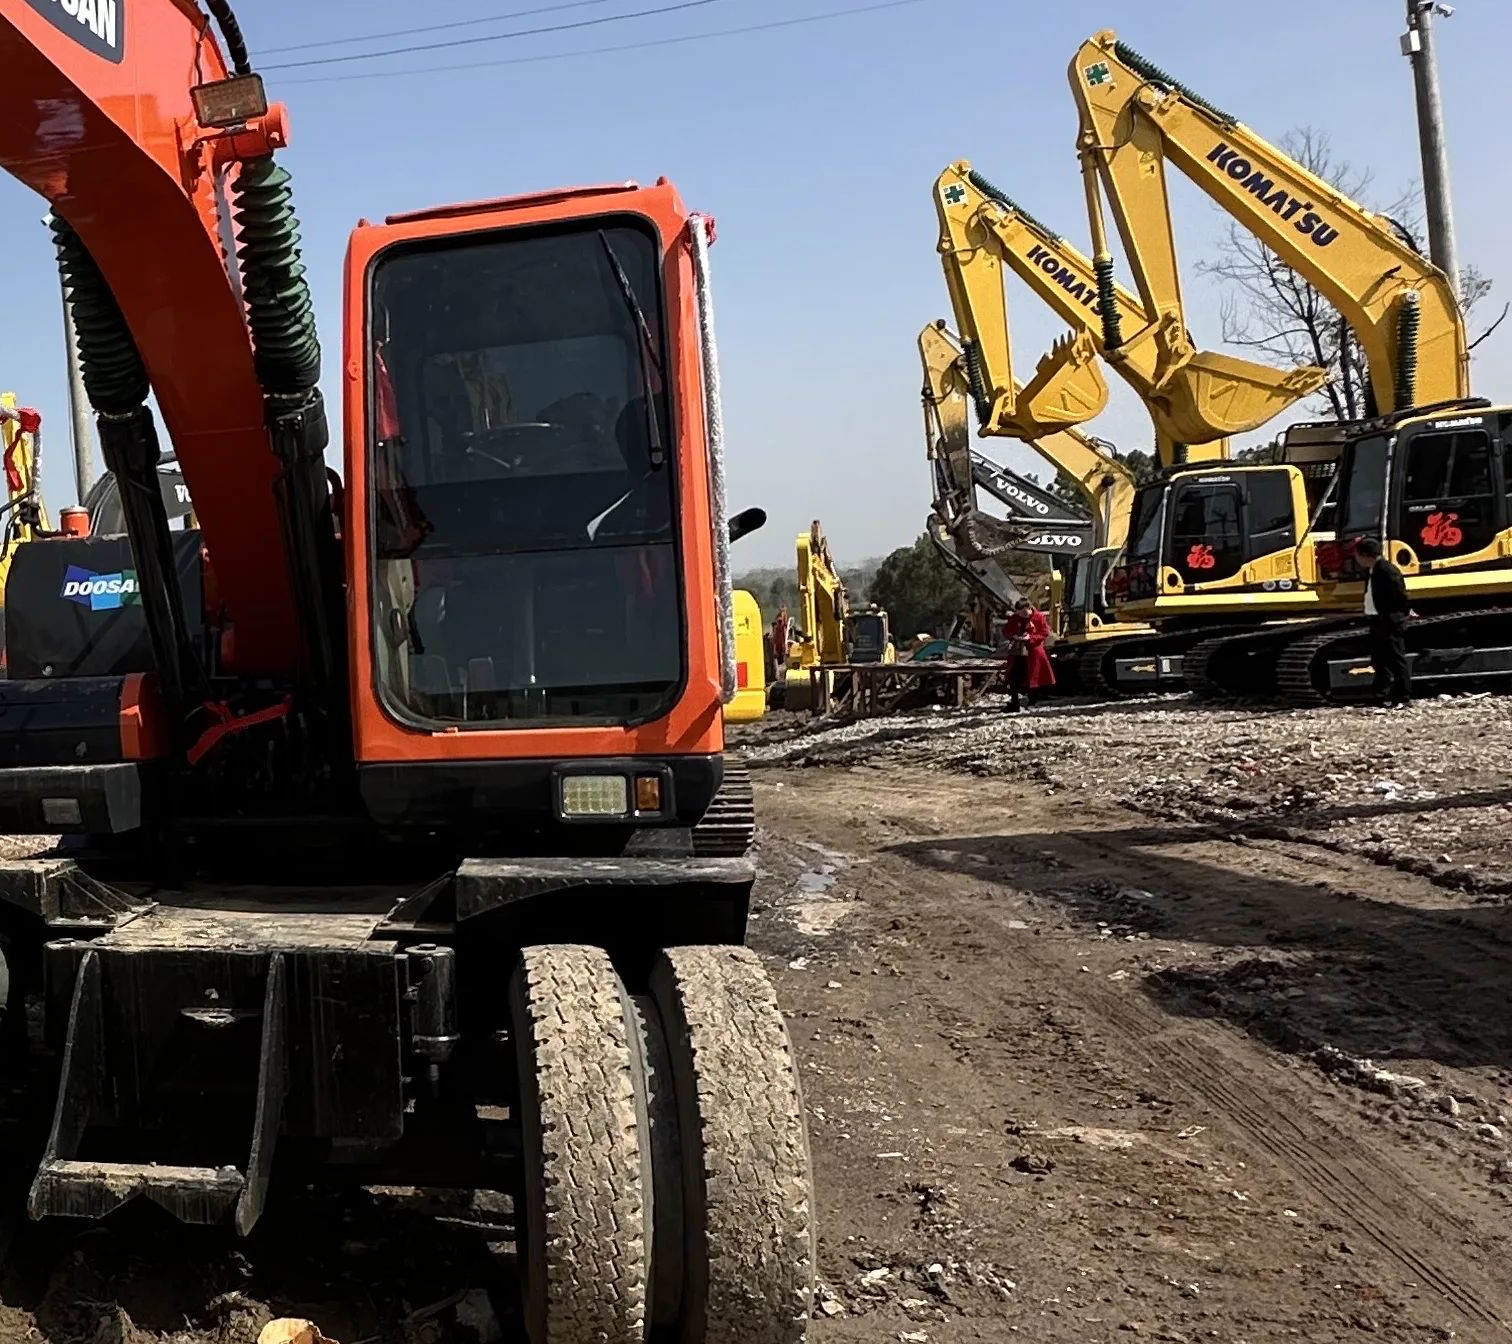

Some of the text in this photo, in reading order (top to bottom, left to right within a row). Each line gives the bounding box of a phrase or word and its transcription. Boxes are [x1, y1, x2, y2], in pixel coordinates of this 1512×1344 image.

[1206, 142, 1340, 247] KOMATSU
[1026, 244, 1123, 318] KOMAT
[996, 477, 1049, 514] VOLVO
[63, 578, 141, 597] DOOSA
